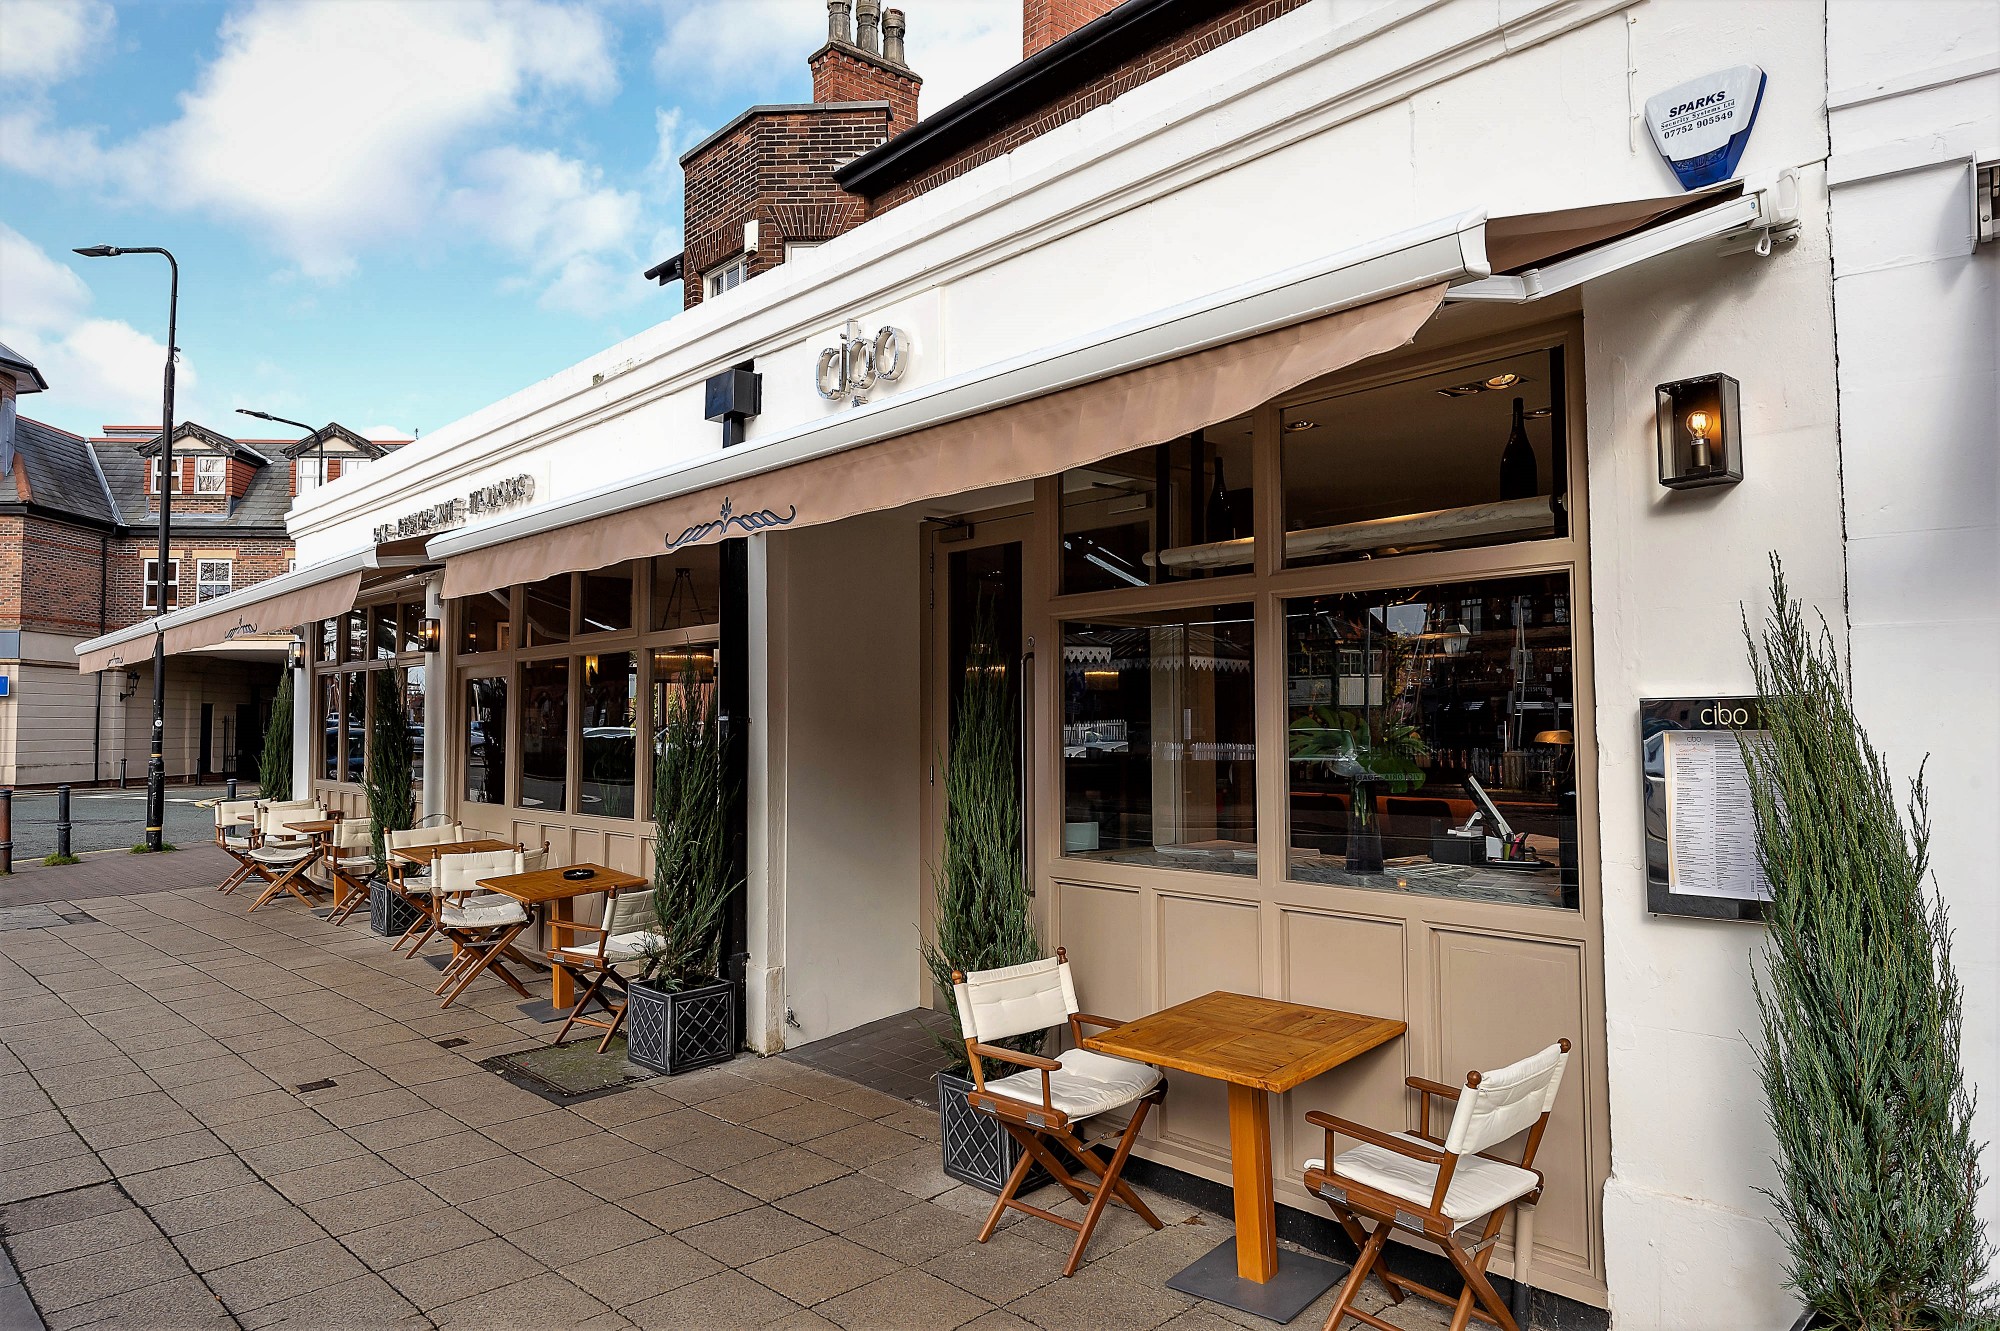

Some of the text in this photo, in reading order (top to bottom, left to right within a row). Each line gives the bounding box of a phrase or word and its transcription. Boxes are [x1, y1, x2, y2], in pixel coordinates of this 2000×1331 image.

[1661, 100, 1735, 129] Security Systems Ltd
[1669, 91, 1726, 118] SPARKS
[1664, 110, 1734, 140] 07752 905549
[816, 319, 909, 401] cibo
[1700, 701, 1749, 726] cibo
